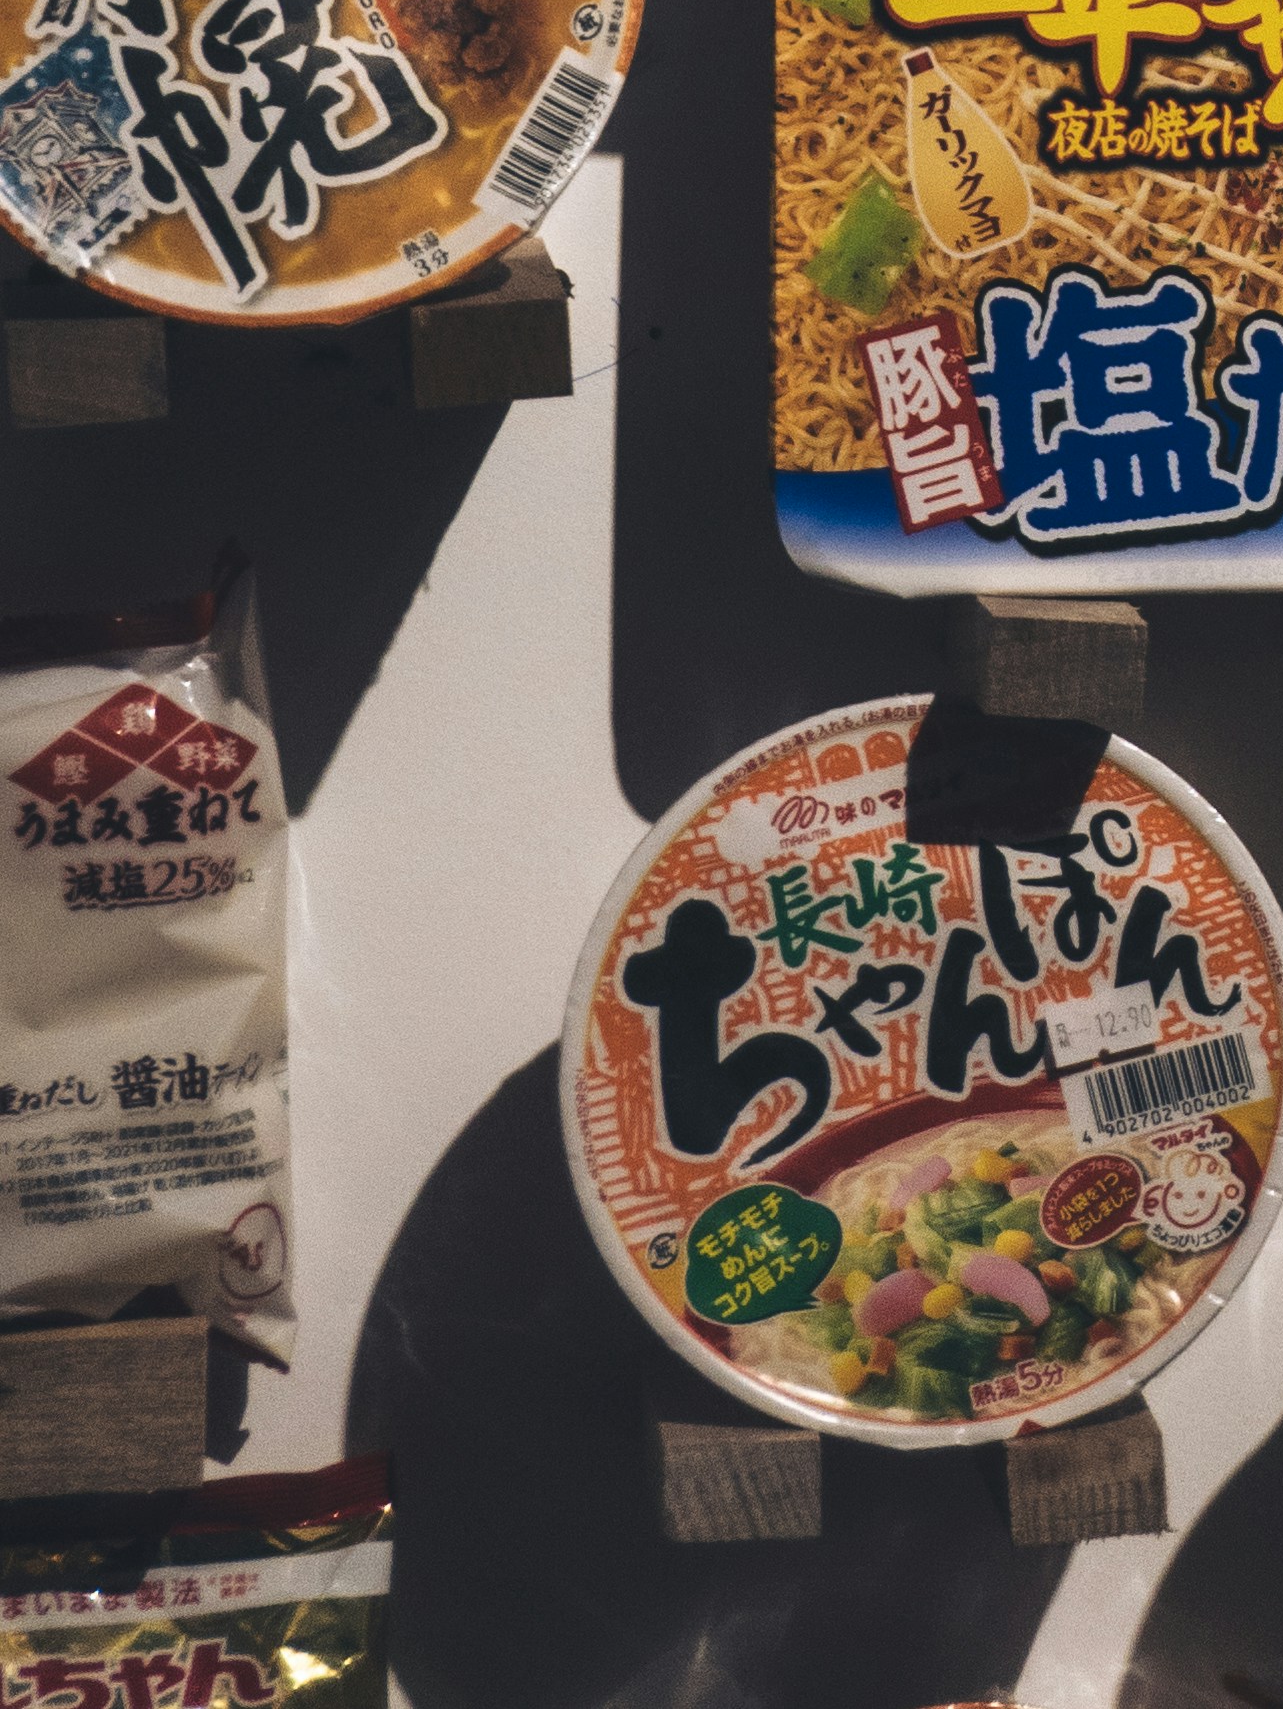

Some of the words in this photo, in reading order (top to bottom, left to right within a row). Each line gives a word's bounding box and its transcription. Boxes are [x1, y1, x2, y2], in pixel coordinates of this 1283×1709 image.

[1046, 98, 1264, 163] 夜店の焼そば
[15, 778, 262, 849] うまみ重ねて
[756, 843, 945, 968] 長崎
